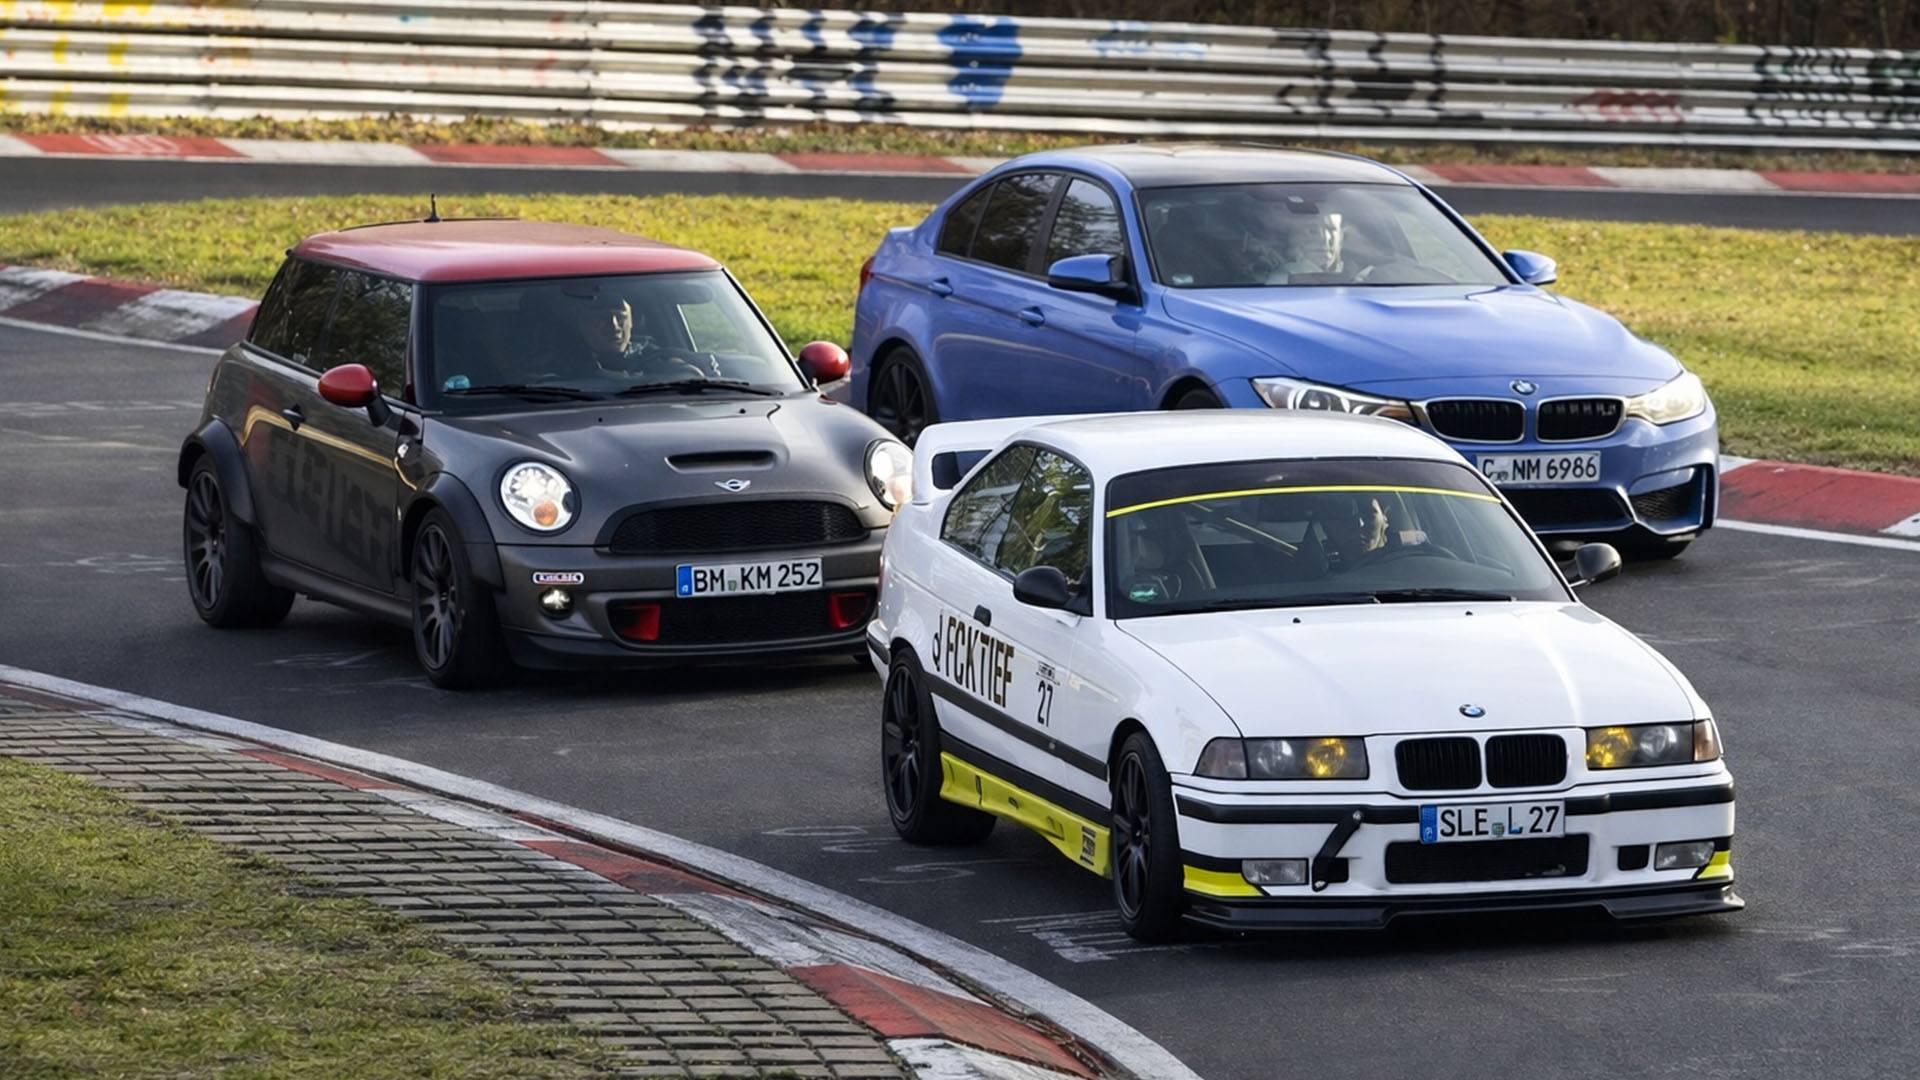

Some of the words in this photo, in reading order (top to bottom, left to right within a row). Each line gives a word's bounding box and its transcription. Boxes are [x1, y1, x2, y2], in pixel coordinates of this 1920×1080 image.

[1512, 458, 1540, 481] NM
[1546, 456, 1597, 479] 6986
[694, 568, 725, 592] BM
[740, 565, 771, 590] KM
[777, 563, 820, 587] 252
[1037, 680, 1053, 727] 27
[1440, 808, 1489, 837] SLE
[1529, 806, 1560, 833] 27
